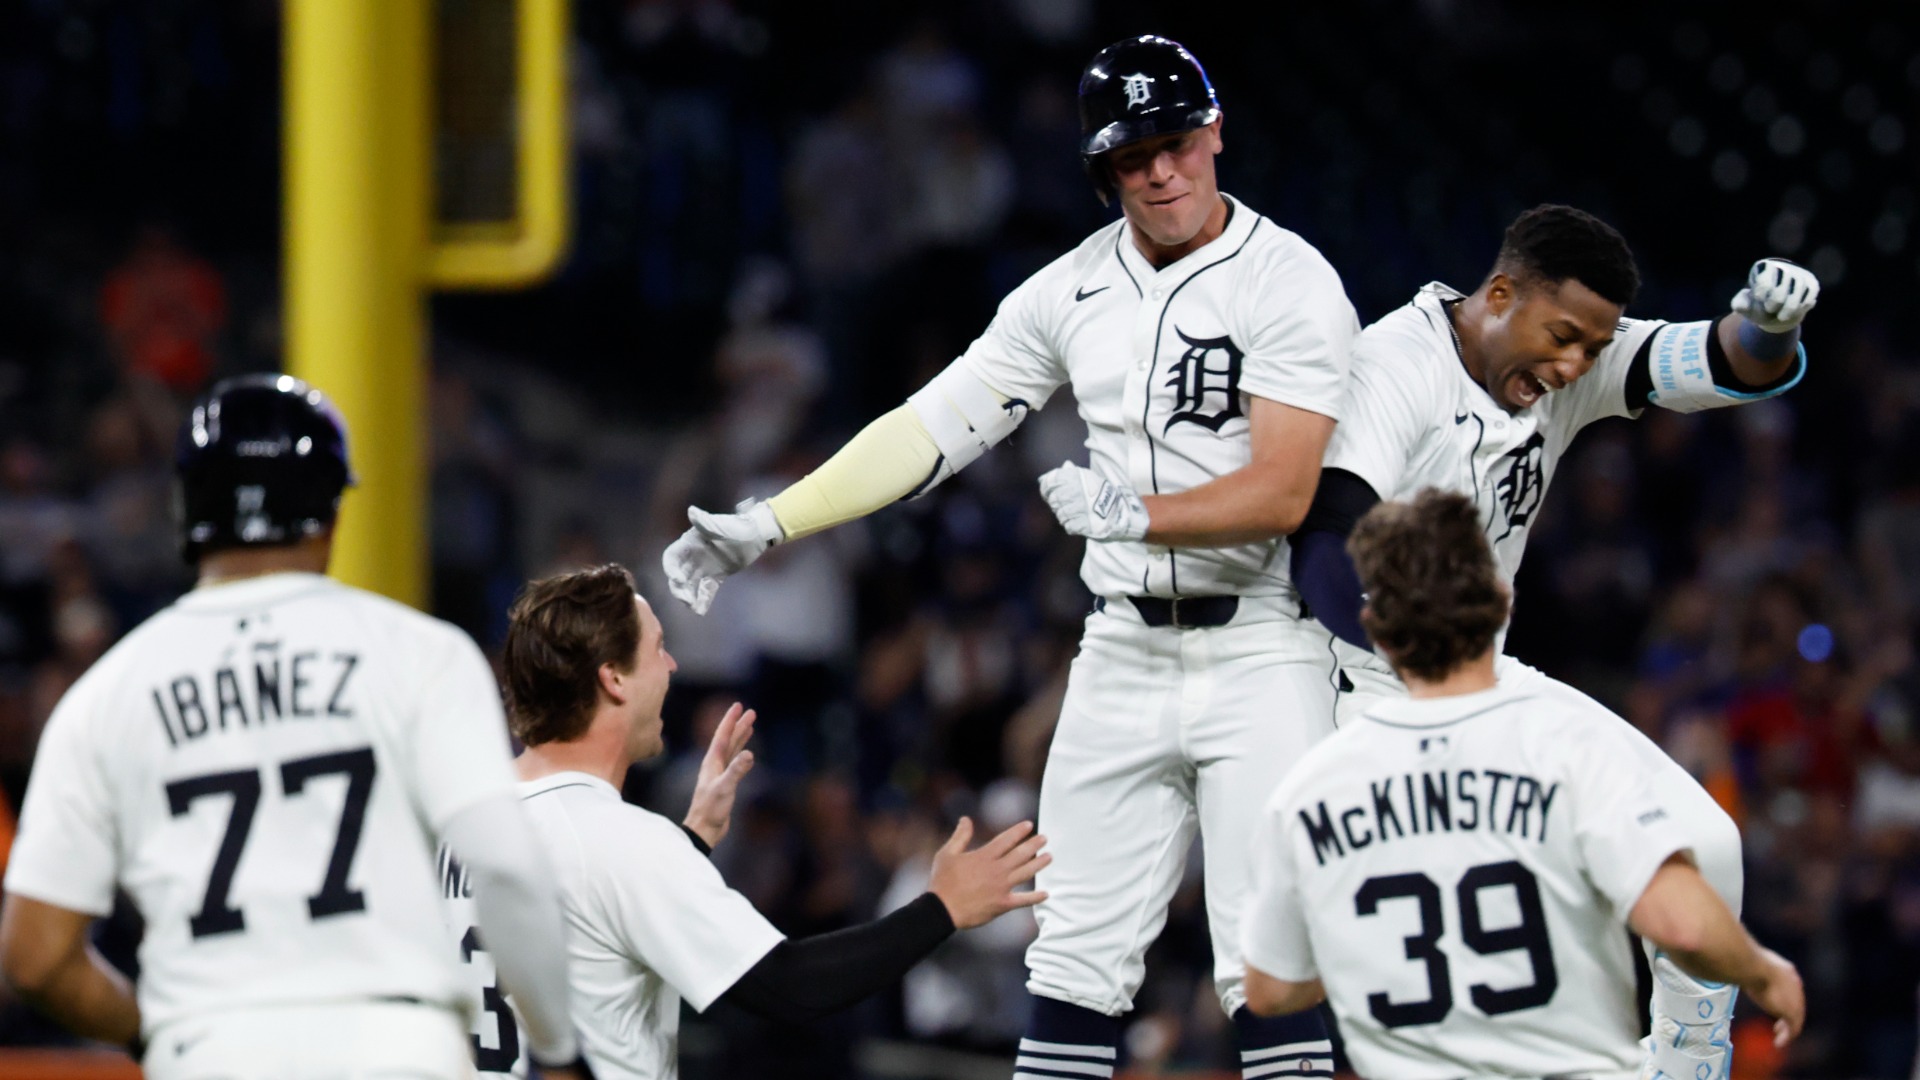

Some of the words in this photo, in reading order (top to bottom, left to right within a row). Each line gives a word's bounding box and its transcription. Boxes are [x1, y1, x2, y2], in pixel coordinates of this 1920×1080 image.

[1120, 72, 1156, 111] D
[1163, 324, 1245, 439] D
[1493, 431, 1545, 544] D
[151, 640, 363, 747] IBÁÑEZ
[164, 745, 377, 941] 77
[1297, 768, 1559, 867] McKINSTRY
[1353, 860, 1559, 1032] 39
